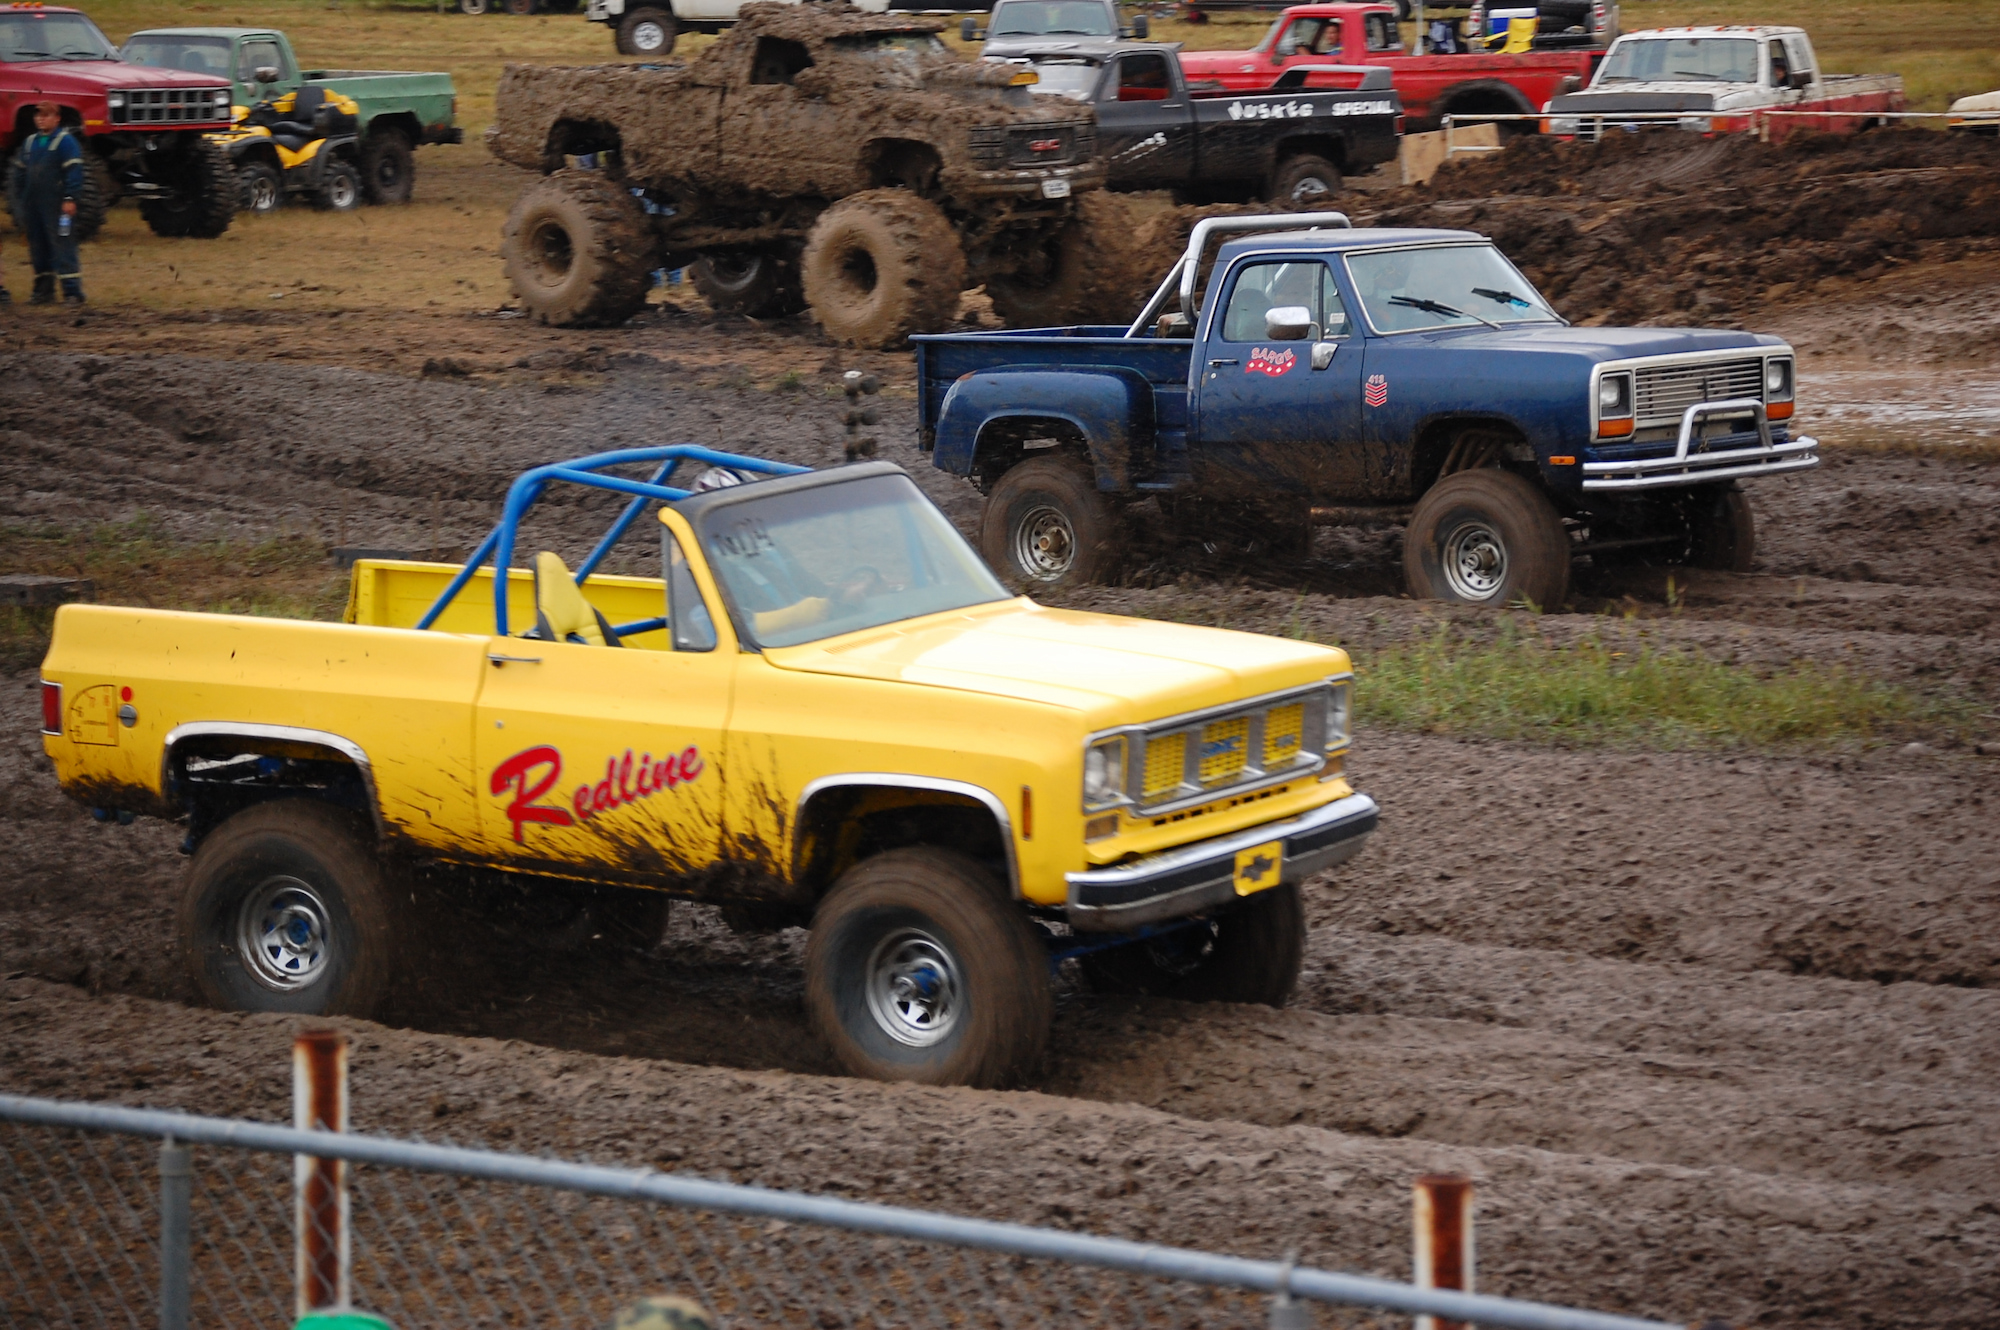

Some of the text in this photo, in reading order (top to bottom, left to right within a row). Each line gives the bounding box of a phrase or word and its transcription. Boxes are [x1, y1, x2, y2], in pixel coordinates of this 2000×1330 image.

[1331, 100, 1395, 116] SPECIAL
[1251, 347, 1295, 365] SARGE
[489, 744, 705, 845] Redline
